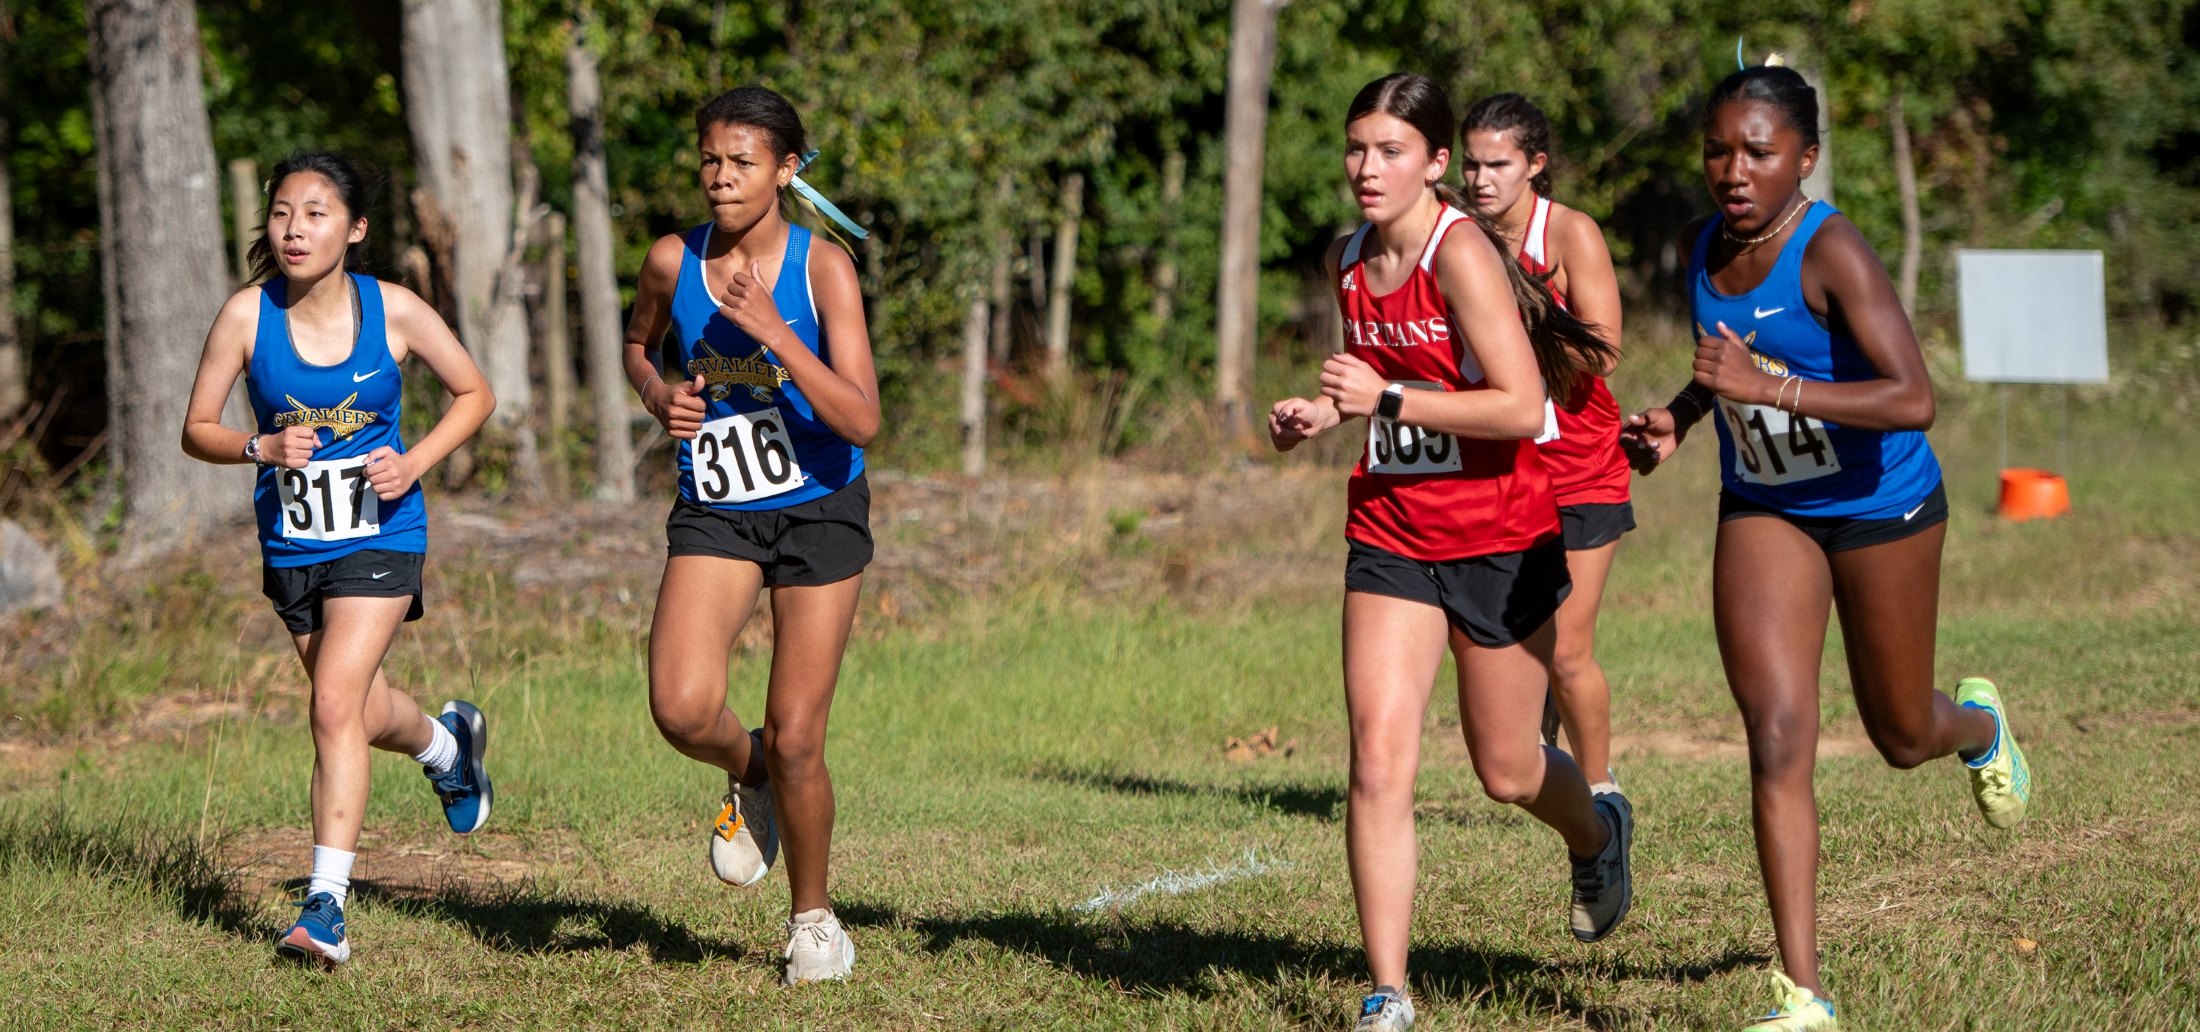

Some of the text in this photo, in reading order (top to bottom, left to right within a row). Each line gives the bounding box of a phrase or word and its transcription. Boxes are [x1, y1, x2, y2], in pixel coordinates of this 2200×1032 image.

[688, 357, 791, 381] CAVALIERS
[273, 408, 378, 427] CAVALIERS
[1726, 405, 1827, 475] 314
[697, 419, 792, 500] 316
[283, 463, 368, 532] 317
